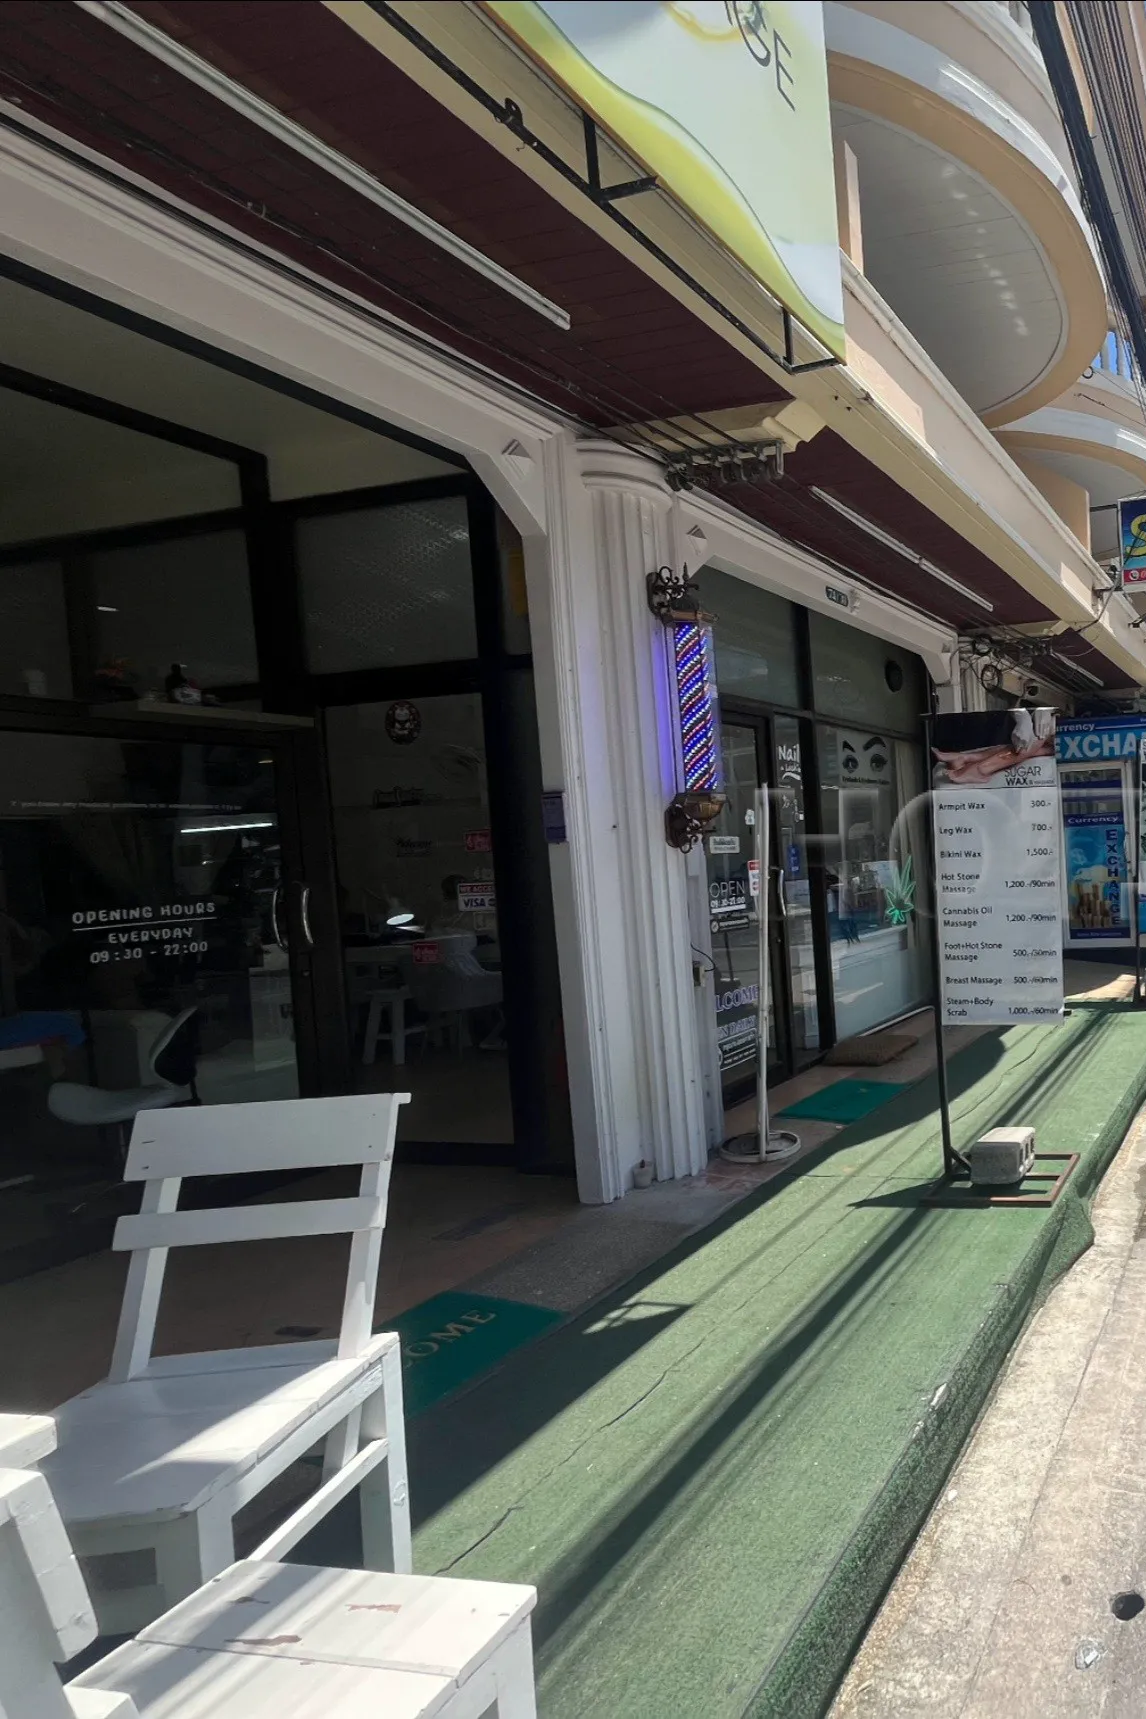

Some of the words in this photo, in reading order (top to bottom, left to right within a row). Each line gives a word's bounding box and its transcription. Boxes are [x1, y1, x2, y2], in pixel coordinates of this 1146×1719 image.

[778, 744, 800, 761] Nail
[1004, 764, 1042, 777] SUGAR
[1005, 777, 1028, 786] WAX
[938, 802, 966, 811] Armpit
[967, 801, 985, 810] Wax
[1067, 816, 1119, 824] Currency
[939, 827, 954, 836] Leg
[940, 850, 963, 859] Bikini
[964, 850, 982, 858] Wax
[941, 873, 955, 881] Hot
[957, 872, 980, 880] Stone
[1105, 829, 1121, 926] EXCHANGE
[709, 880, 746, 898] OPEN
[941, 884, 976, 894] Massage
[464, 898, 486, 908] VISA
[72, 906, 153, 924] OPENING
[160, 902, 216, 916] HOURS
[942, 907, 979, 915] Cannabis
[981, 906, 993, 914] Oil
[943, 919, 978, 928] Massage
[108, 927, 194, 944] EVERYDAY
[163, 941, 208, 956] 22:00
[944, 942, 979, 950] Foot+Hot
[981, 941, 1003, 949] Stone
[944, 954, 979, 962] Massage
[945, 976, 969, 984] Breast
[970, 976, 1003, 985] Massage
[946, 997, 994, 1006] Steam+Body
[403, 1309, 497, 1368] OME
